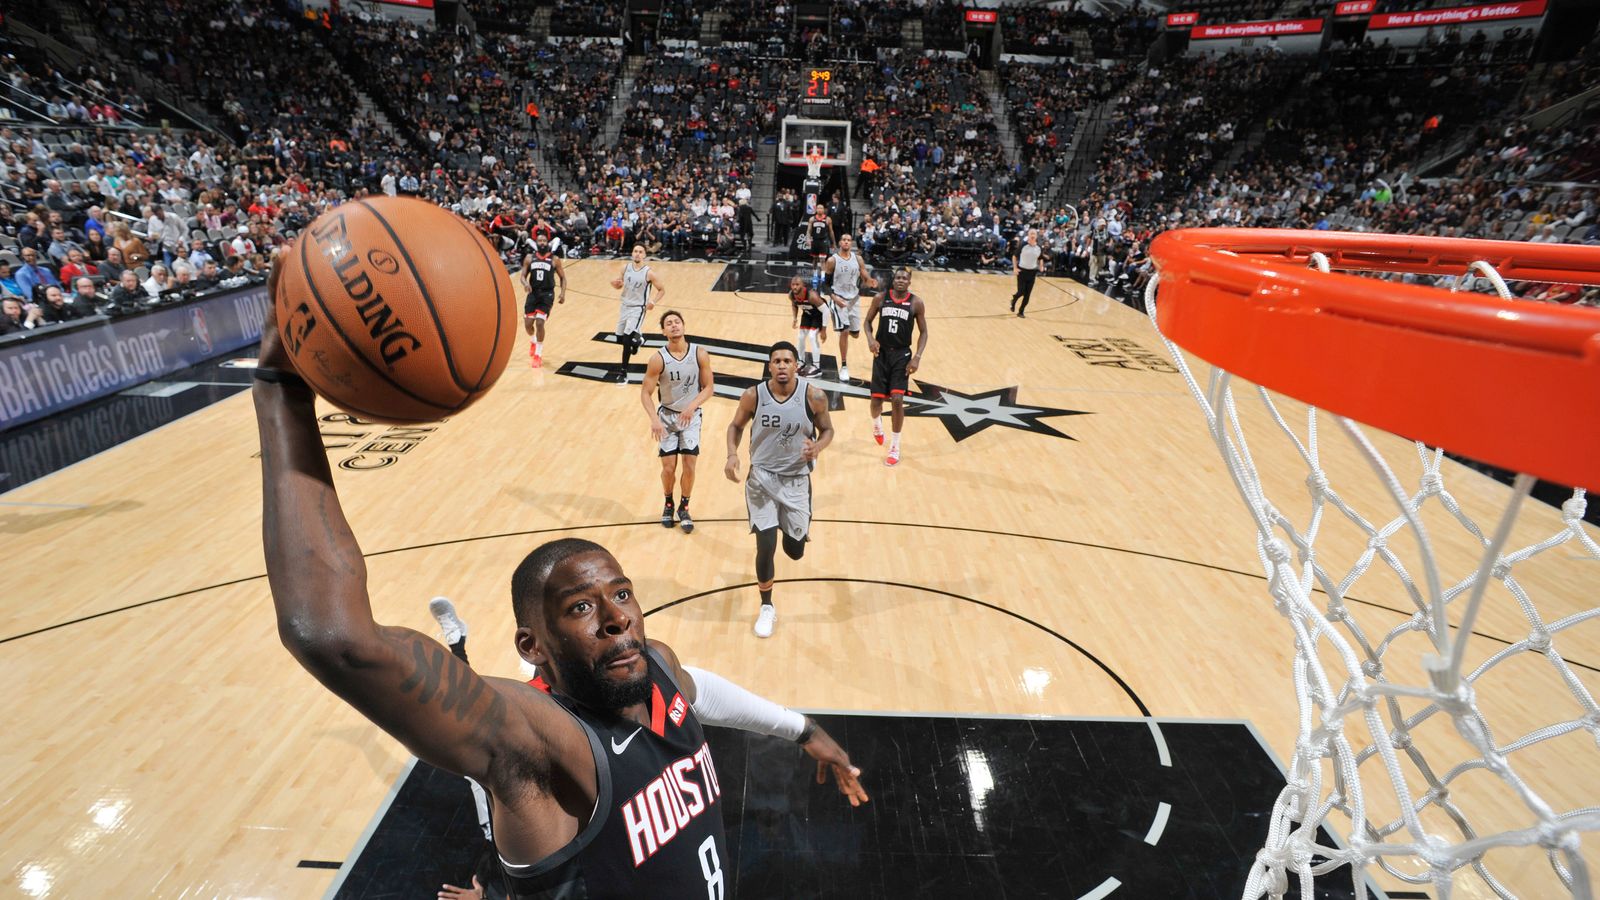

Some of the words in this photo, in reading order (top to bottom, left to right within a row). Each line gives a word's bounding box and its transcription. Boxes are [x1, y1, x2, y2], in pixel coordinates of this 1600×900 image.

[1388, 15, 1411, 24] Here
[1413, 10, 1479, 22] Everything's
[1480, 5, 1520, 16] Better.
[1205, 27, 1224, 35] Here
[1225, 24, 1274, 35] Everything's
[811, 70, 830, 81] 9:49
[807, 80, 829, 97] 21
[311, 212, 422, 370] SPALDING
[881, 306, 910, 320] HOUSTON
[888, 318, 899, 334] 15
[669, 371, 681, 381] 11
[761, 414, 781, 428] 22
[338, 425, 440, 471] CEN
[698, 834, 725, 900] 8
